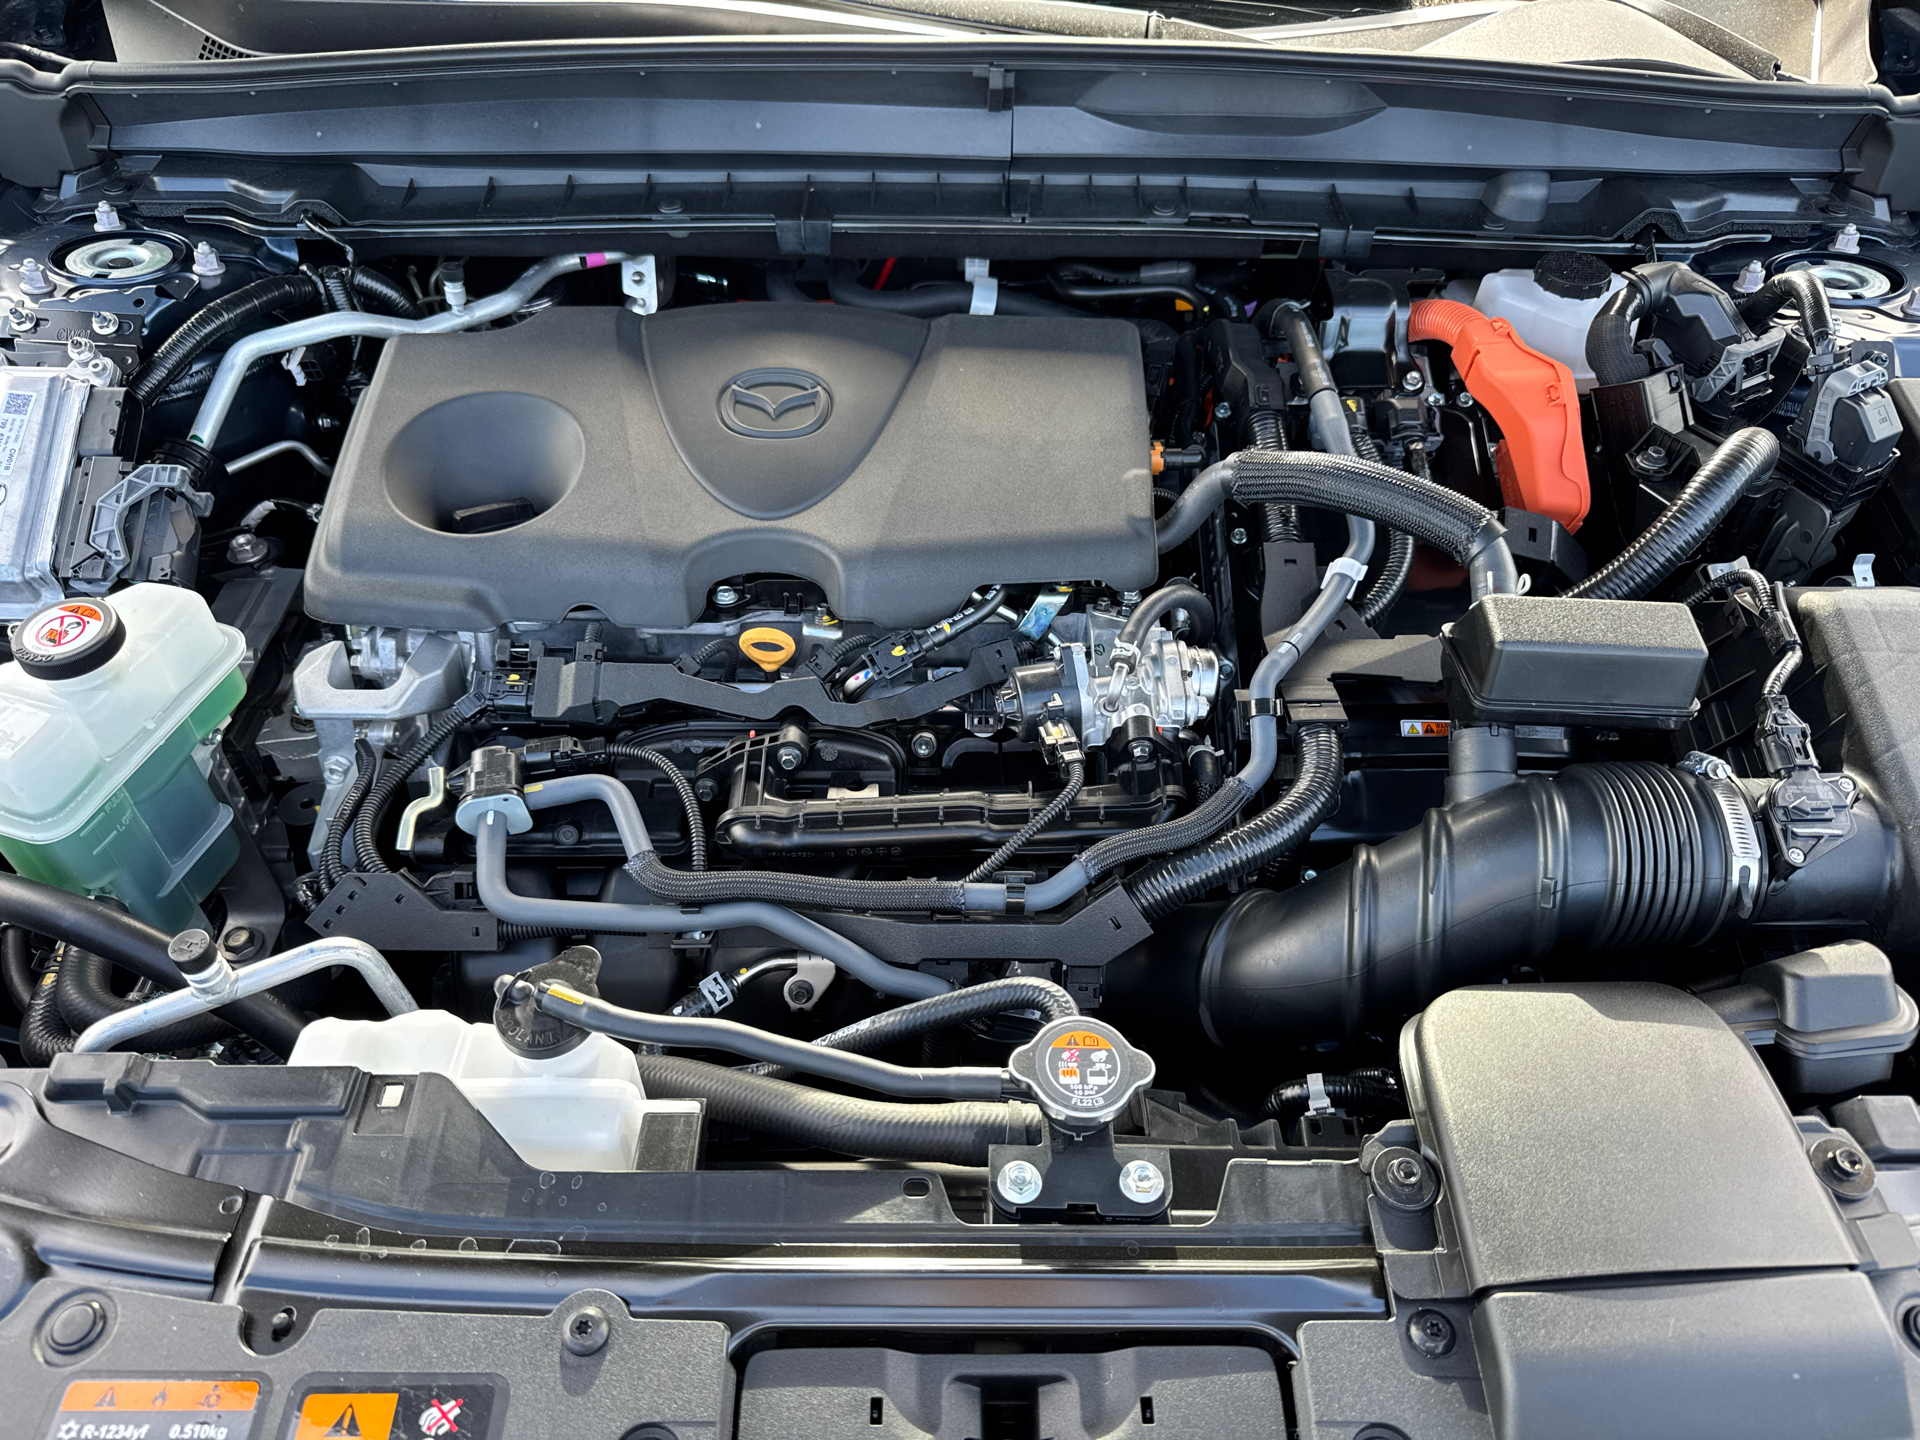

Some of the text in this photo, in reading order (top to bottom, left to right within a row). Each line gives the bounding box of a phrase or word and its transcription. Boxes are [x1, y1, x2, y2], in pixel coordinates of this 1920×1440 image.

[14, 648, 55, 664] DENSO
[116, 808, 134, 832] LOW
[500, 1012, 557, 1045] COOLANT
[1071, 1097, 1093, 1106] FL22
[80, 1423, 228, 1440] R-1234yf 0.510kg
